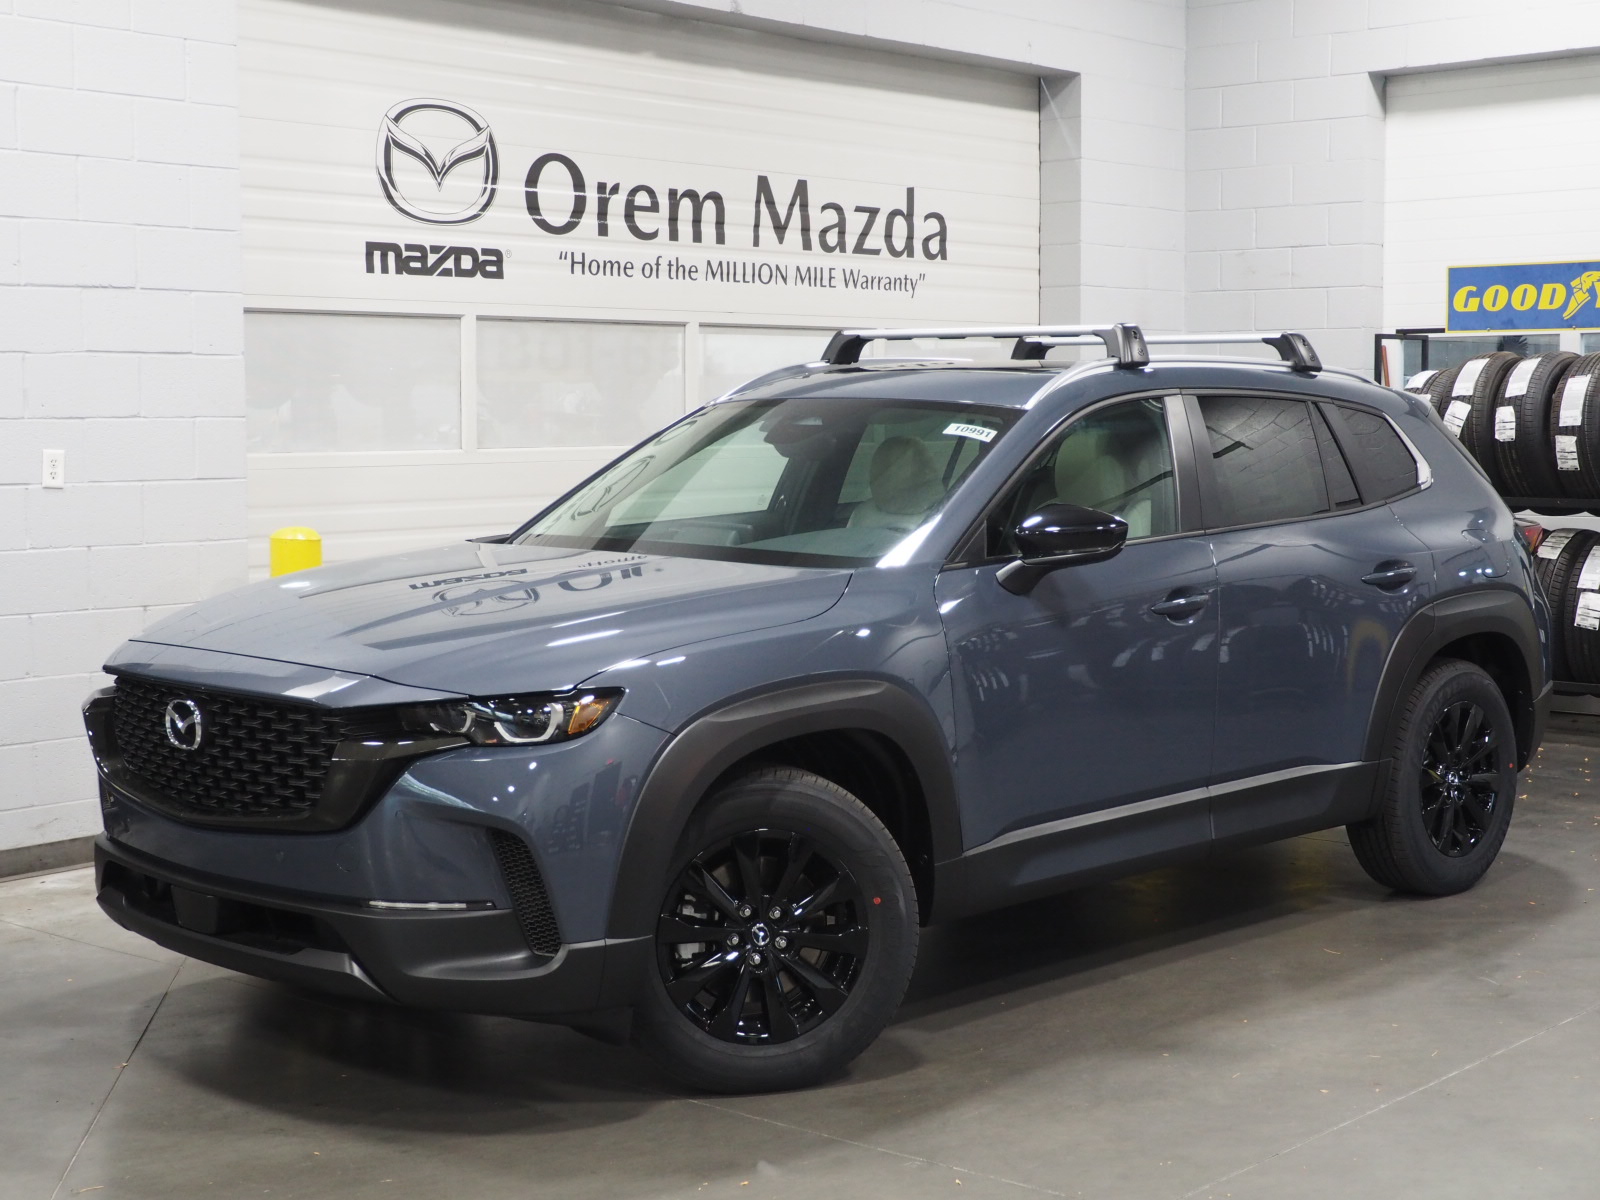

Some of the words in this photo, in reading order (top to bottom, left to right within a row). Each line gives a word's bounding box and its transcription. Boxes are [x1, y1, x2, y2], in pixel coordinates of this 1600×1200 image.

[524, 152, 726, 246] Orem
[752, 174, 949, 261] Mazda
[641, 255, 663, 279] of
[667, 256, 699, 281] the
[705, 259, 788, 286] MILLION
[794, 265, 837, 289] MILE
[1453, 281, 1600, 312] GOOD
[954, 425, 992, 438] 10991
